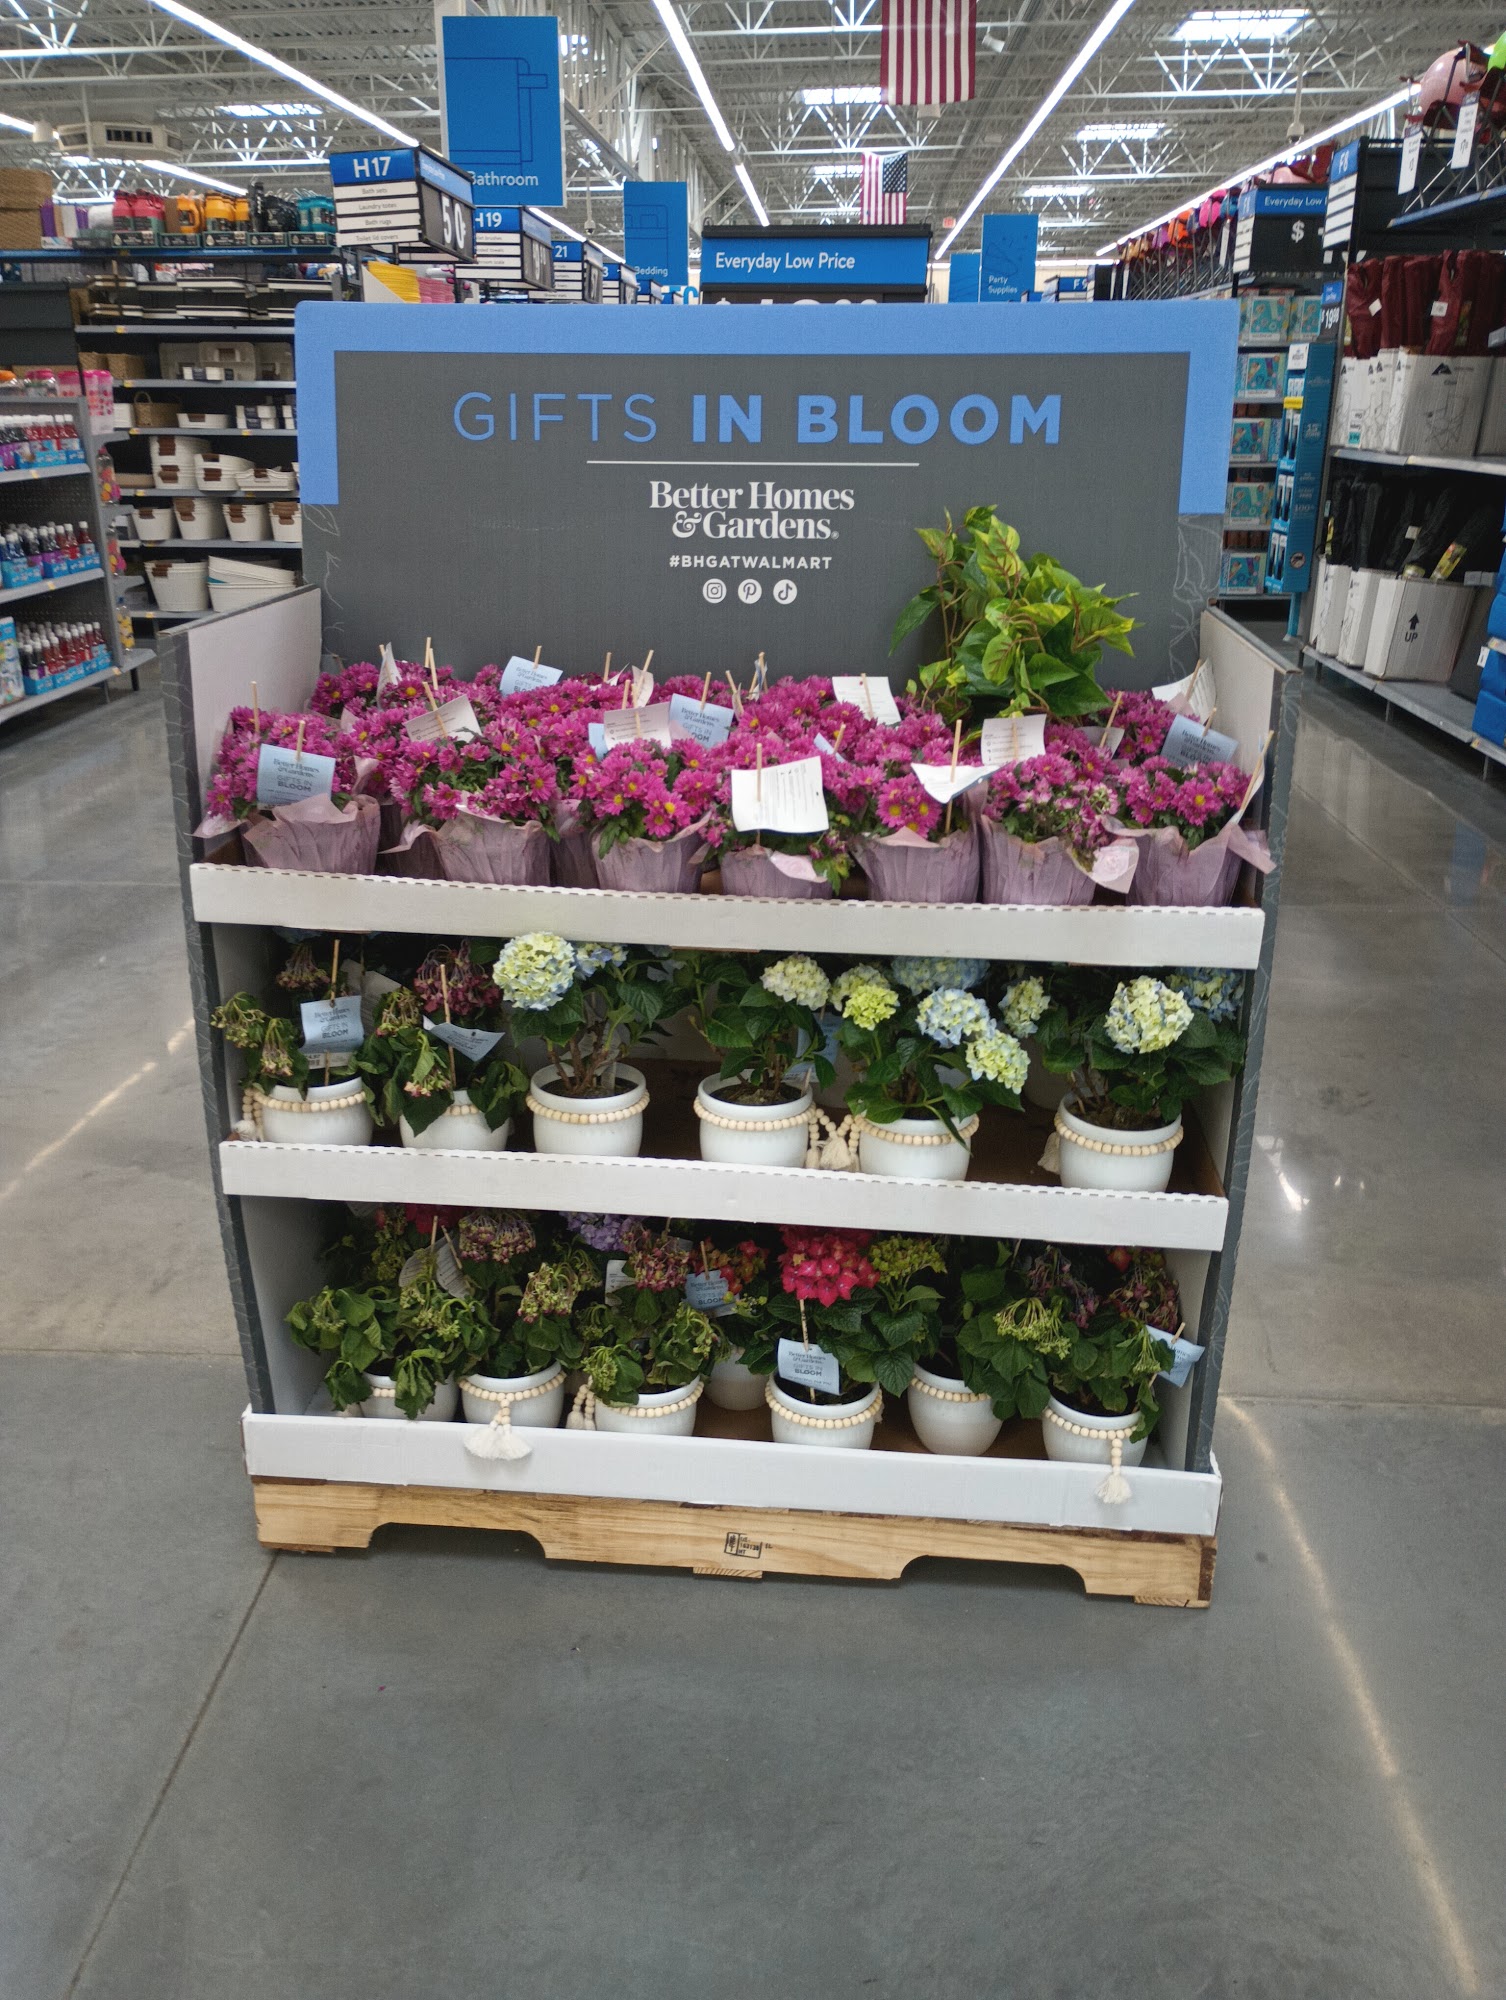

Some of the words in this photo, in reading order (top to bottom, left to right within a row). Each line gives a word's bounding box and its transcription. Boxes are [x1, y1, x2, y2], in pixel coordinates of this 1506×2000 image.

[353, 156, 391, 178] H17
[1264, 196, 1304, 208] Everyday
[1306, 197, 1324, 206] Low
[554, 245, 568, 258] 21
[715, 252, 781, 273] Everyday
[785, 252, 814, 269] Low
[818, 252, 855, 269] Price
[988, 275, 1008, 284] Party
[988, 286, 1018, 295] Supplies
[453, 391, 657, 443] GIFTS
[692, 394, 762, 443] IN
[797, 394, 1061, 445] BLOOM
[649, 481, 744, 509] Better
[748, 481, 855, 510] Homes
[669, 555, 832, 570] #BHGATWALMART
[1404, 632, 1418, 643] UP
